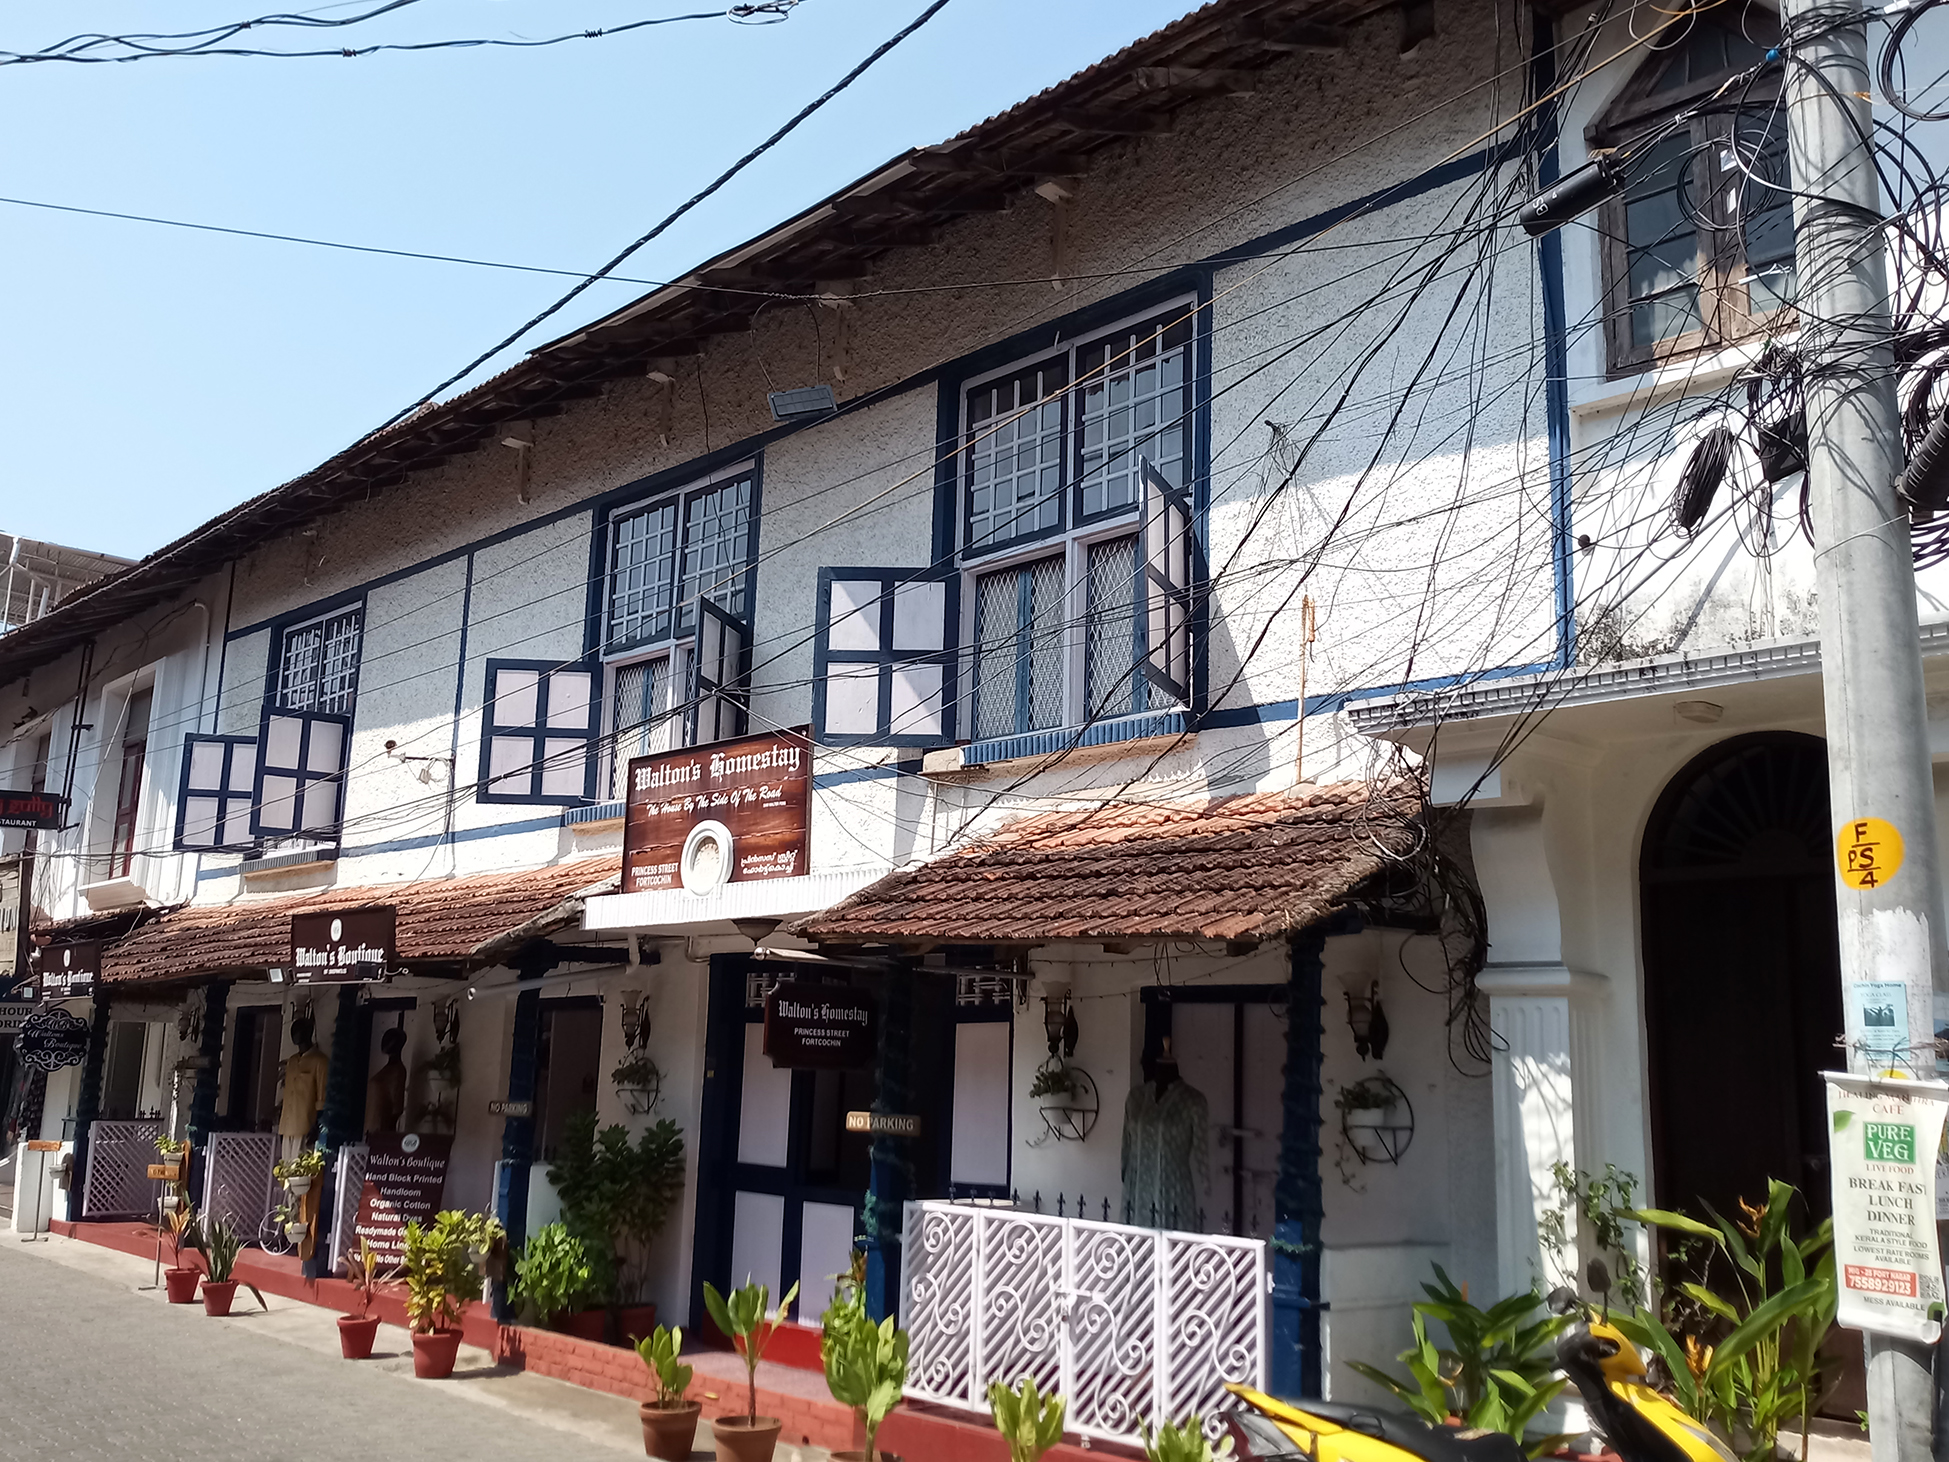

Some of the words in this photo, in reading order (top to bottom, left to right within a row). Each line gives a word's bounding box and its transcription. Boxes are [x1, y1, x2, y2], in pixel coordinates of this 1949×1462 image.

[635, 759, 701, 791] Walton's
[709, 744, 801, 783] Homestay
[647, 803, 660, 817] The
[660, 802, 682, 815] House
[683, 797, 695, 813] By
[696, 796, 710, 809] The
[711, 793, 729, 807] Side
[730, 790, 742, 808] Of
[743, 788, 757, 802] The
[759, 785, 783, 800] Road
[1854, 822, 1868, 843] F
[631, 865, 658, 877] PRINCESS
[658, 862, 679, 875] STREET
[636, 874, 672, 887] FORTCOCHIN
[1859, 871, 1878, 888] 4
[295, 943, 336, 967] Walton's
[778, 1000, 819, 1020] Walton's
[821, 1003, 868, 1026] Homestay
[794, 1027, 826, 1037] PRINCESS
[826, 1029, 850, 1037] STREET
[801, 1037, 842, 1047] FORTCOCHIN
[1873, 1104, 1904, 1115] CAFE
[849, 1116, 864, 1128] NO
[867, 1116, 914, 1132] PARKING
[1866, 1124, 1912, 1141] PURE
[1867, 1140, 1910, 1160] VEG
[370, 1153, 406, 1167] Walton's
[406, 1156, 446, 1171] Boutique
[1866, 1164, 1886, 1172] LIVE
[1889, 1166, 1914, 1175] FOOD
[365, 1171, 387, 1181] Hand
[388, 1173, 412, 1183] Block
[413, 1174, 443, 1184] Printed
[1848, 1177, 1894, 1192] BREAK
[380, 1186, 421, 1197] Handloom
[370, 1198, 401, 1210] Organic
[403, 1200, 431, 1210] Cotton
[1868, 1194, 1913, 1210] LUNCH
[371, 1211, 401, 1222] Natural
[1867, 1210, 1916, 1226] DINNER
[355, 1225, 396, 1238] Readymade
[1869, 1228, 1914, 1240] TRADITIONAL
[367, 1238, 389, 1249] Home
[1886, 1238, 1906, 1246] STYLE
[1908, 1240, 1928, 1249] FOOD
[1853, 1245, 1884, 1255] LOWEST
[1886, 1249, 1903, 1257] RATE
[1905, 1251, 1930, 1260] ROOMS
[1874, 1255, 1912, 1265] AVAILABLE
[1849, 1275, 1912, 1295] 7558929123
[1863, 1296, 1884, 1305] MESS
[1885, 1299, 1926, 1312] AVAILABLE
